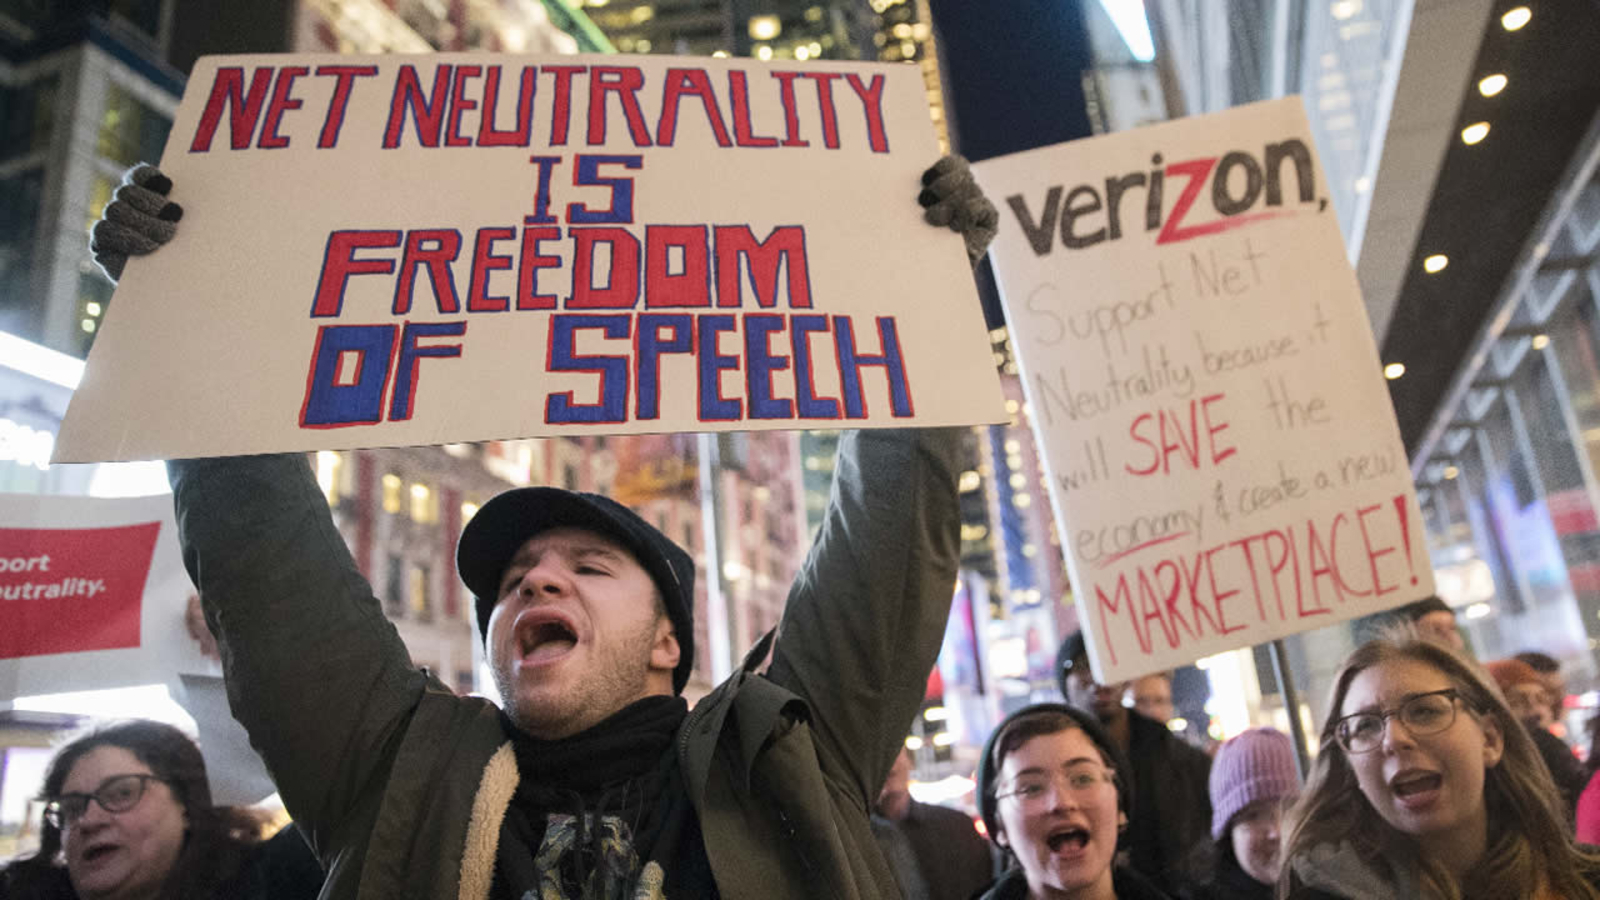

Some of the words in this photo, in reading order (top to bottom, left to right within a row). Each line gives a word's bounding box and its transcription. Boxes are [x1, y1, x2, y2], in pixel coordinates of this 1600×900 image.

[188, 65, 379, 153] NET
[382, 64, 890, 153] NEUTRALITY
[524, 153, 644, 225] IS
[310, 224, 814, 318] FREEDOM
[1027, 260, 1175, 361] Support
[1189, 238, 1268, 298] Net
[299, 320, 468, 430] OF
[544, 312, 915, 424] SPEECH
[1036, 344, 1198, 428] Neutrality
[1194, 329, 1302, 376] because
[1308, 302, 1332, 345] it
[1057, 437, 1110, 492] will
[1124, 393, 1238, 477] SAVE
[1263, 374, 1331, 431] the
[1076, 504, 1205, 562] economy
[1239, 459, 1310, 516] create
[1314, 470, 1335, 489] a
[1337, 446, 1397, 483] new
[0, 577, 107, 601] utrality.
[1094, 493, 1420, 667] MARKETPLACE!
